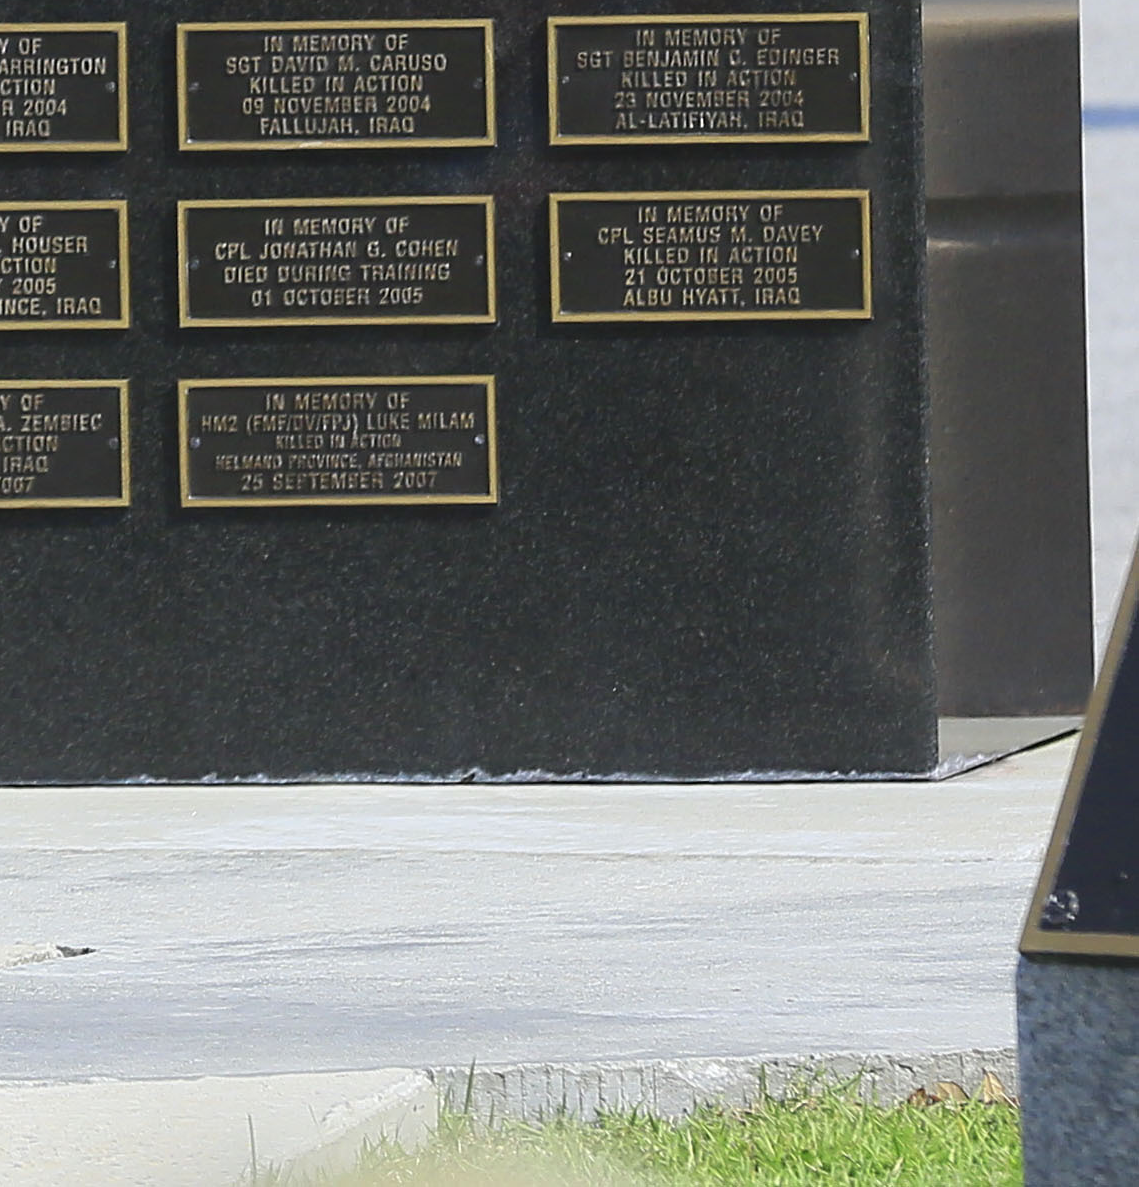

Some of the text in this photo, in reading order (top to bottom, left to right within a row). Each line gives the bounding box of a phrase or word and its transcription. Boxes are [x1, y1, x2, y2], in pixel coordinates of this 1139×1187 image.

[264, 33, 408, 52] IN MEMORY OF
[636, 27, 780, 46] IN MEMORY OF
[226, 53, 446, 74] SGT DAVID M. CARUSO
[250, 74, 422, 94] KILLED IN ACTION
[24, 98, 66, 116] 2004
[242, 94, 430, 114] 09 NOVEMBER 2004
[6, 119, 50, 137] IRAQ
[12, 235, 87, 254] HOUSER
[215, 239, 457, 260] CPL JONATHAN G. COHEN
[624, 245, 797, 265] KILLED IN ACTION
[224, 262, 449, 283] DIED DURING TRAINING
[12, 277, 56, 295] 2005
[57, 297, 101, 314] IRAQ
[623, 288, 671, 306] ALBU
[755, 287, 800, 305] IRAQ
[266, 391, 409, 410] IN MEMORY OF
